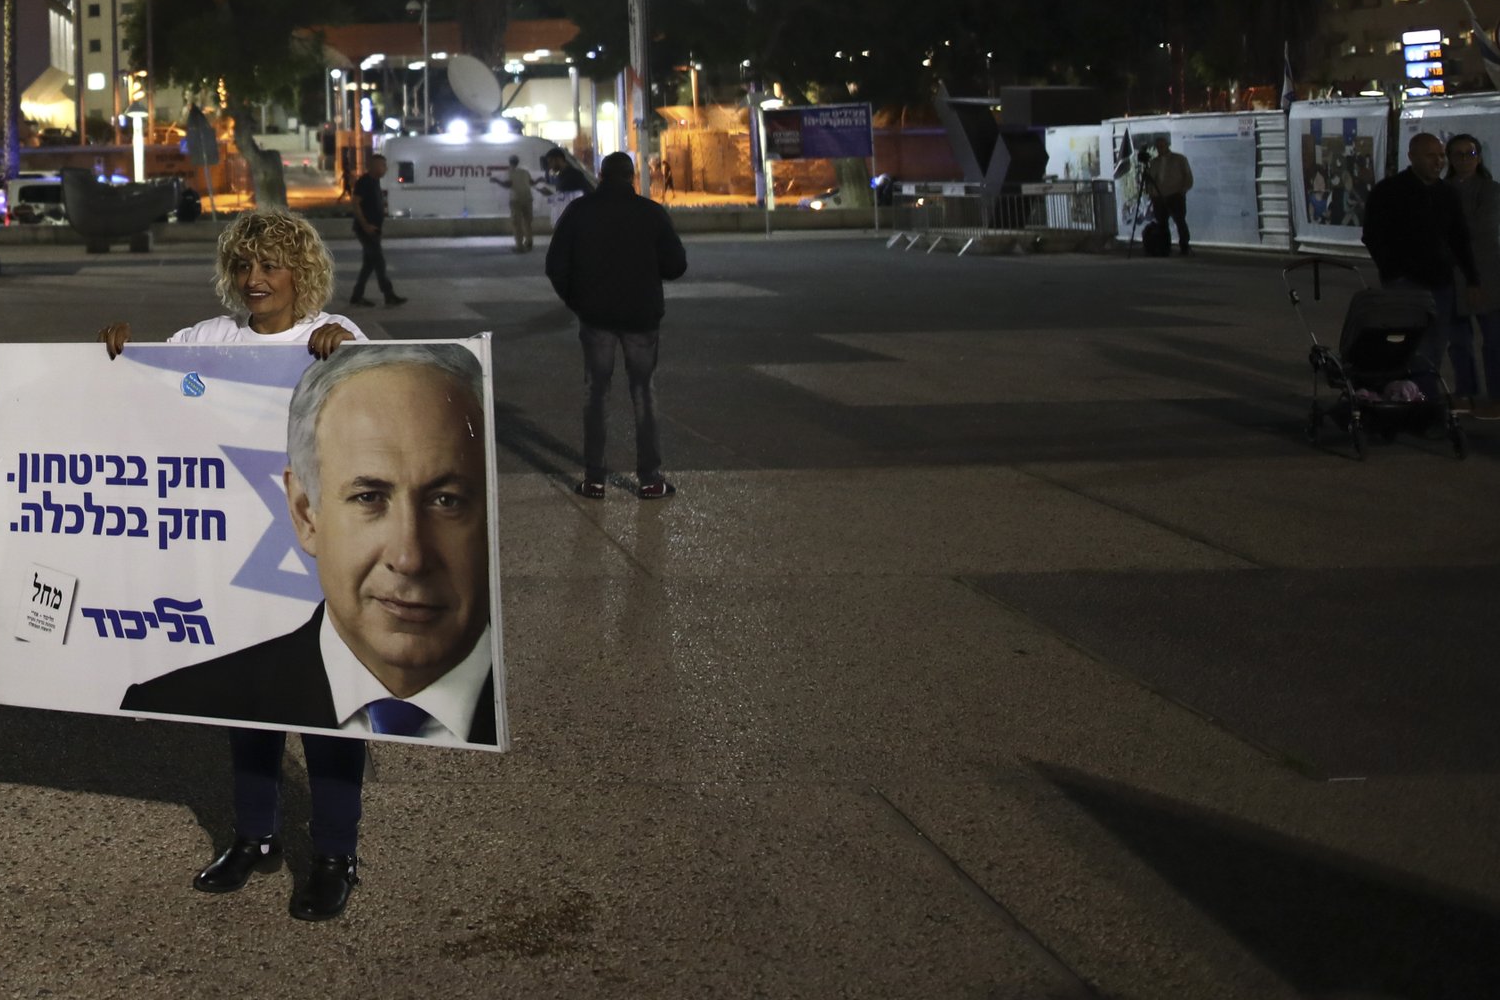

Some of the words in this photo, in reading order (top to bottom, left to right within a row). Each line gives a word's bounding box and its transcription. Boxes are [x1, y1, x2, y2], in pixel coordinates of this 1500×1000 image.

[428, 165, 485, 178] החדשות
[7, 453, 148, 493] בביטחון.
[157, 457, 225, 498] חזק
[10, 490, 148, 537] בכלכלה.
[158, 508, 226, 549] חזק
[32, 572, 62, 609] מחל
[81, 598, 214, 645] הליכוד
